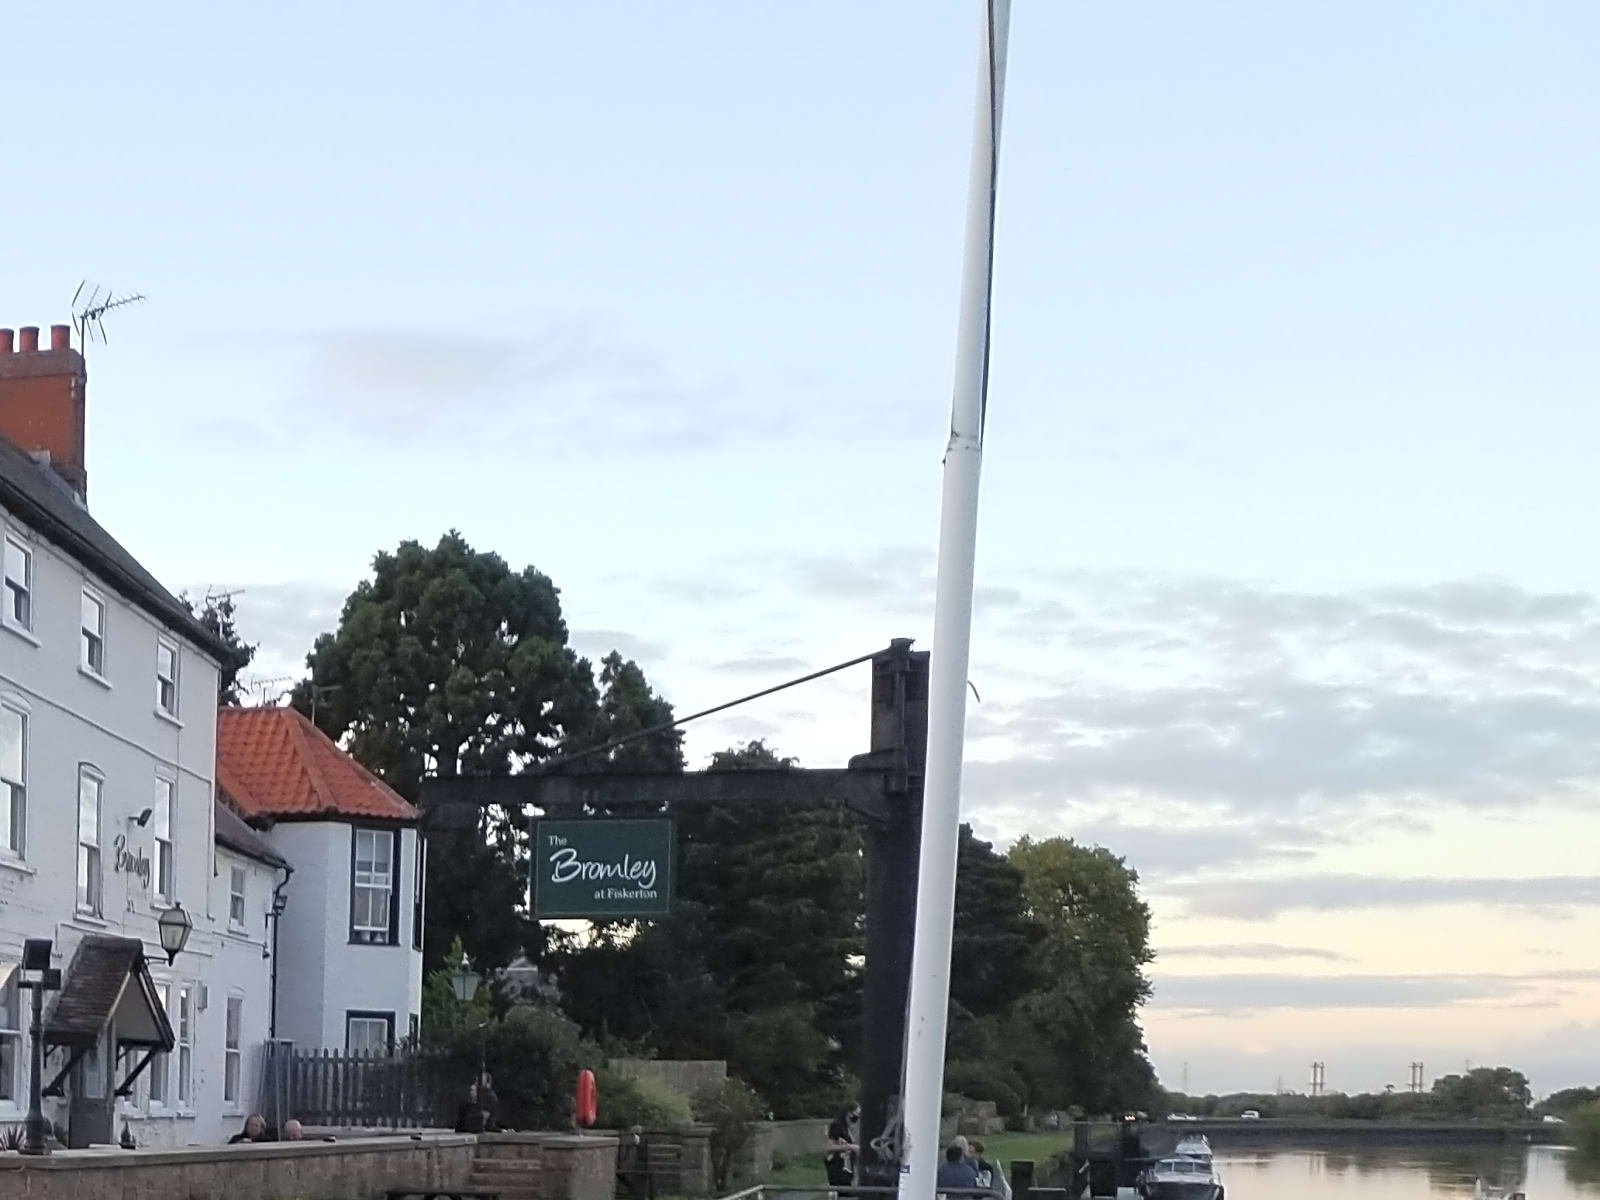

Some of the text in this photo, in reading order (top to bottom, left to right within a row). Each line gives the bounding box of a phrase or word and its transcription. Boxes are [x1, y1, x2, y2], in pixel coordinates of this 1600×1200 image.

[548, 835, 568, 846] The
[549, 848, 657, 889] Bromley
[594, 888, 658, 899] at Fiskerton
